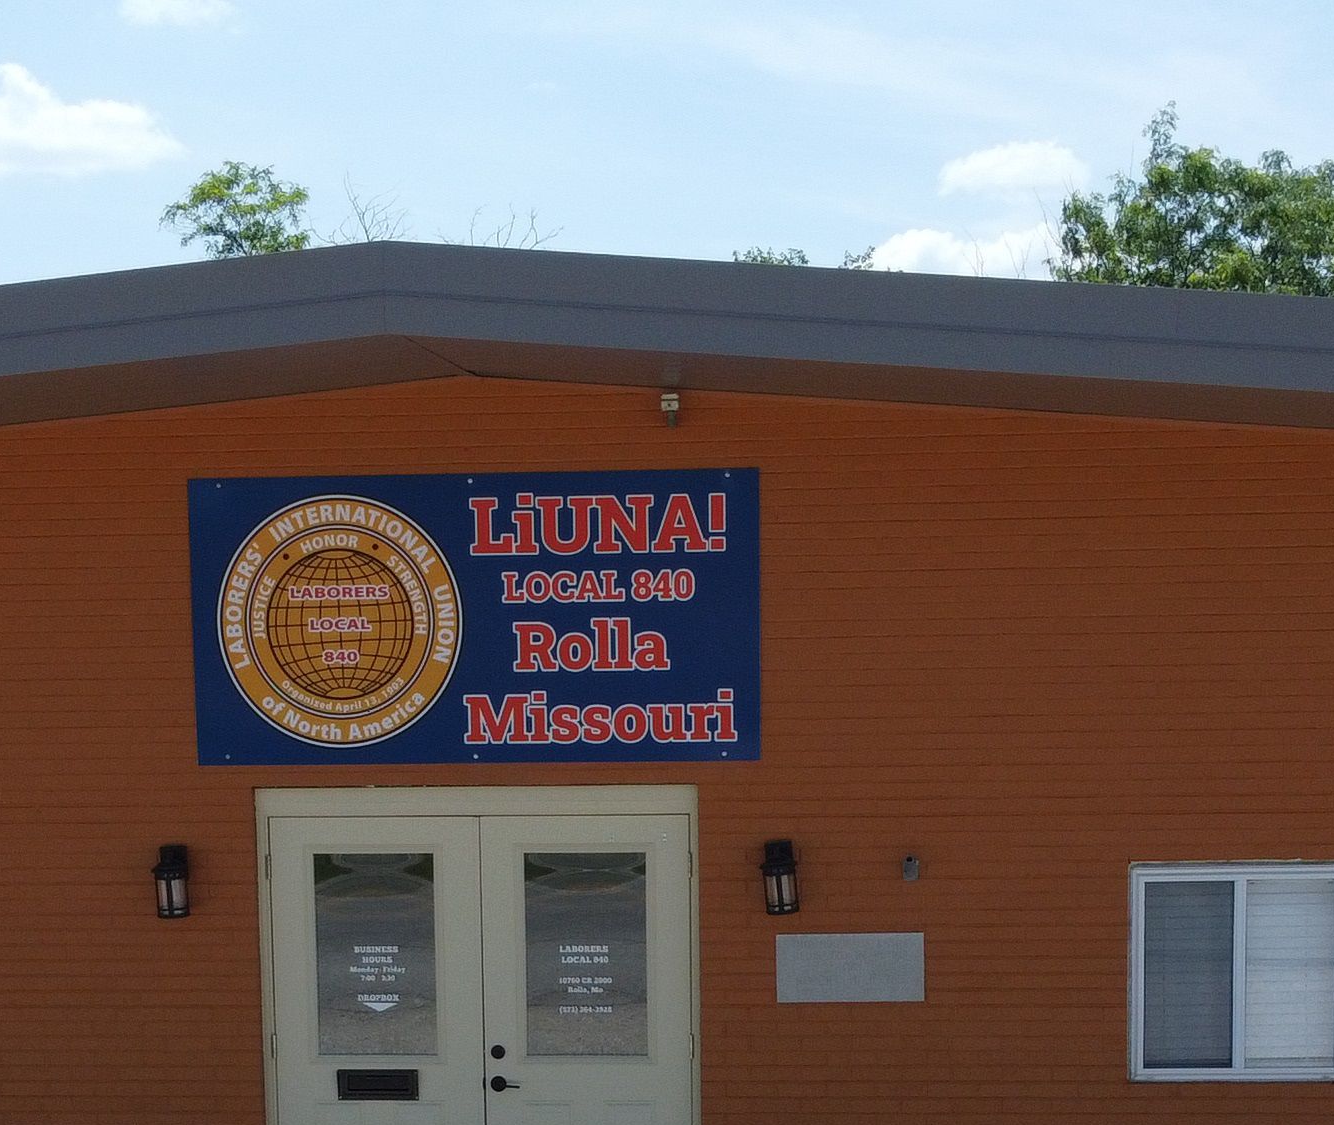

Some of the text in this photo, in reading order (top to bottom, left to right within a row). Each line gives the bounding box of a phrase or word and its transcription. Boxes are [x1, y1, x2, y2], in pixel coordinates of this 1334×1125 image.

[469, 492, 726, 556] LiUNA!
[300, 534, 359, 554] HONOR
[268, 504, 436, 574] INTERNATIONAL
[433, 584, 455, 664] UNION
[288, 584, 390, 601] LABORERS
[386, 555, 428, 635] STRENGTH
[501, 568, 695, 603] LOCAL 840
[253, 575, 278, 640] JUSTICE
[307, 617, 372, 632] LOCAL
[321, 650, 359, 664] 840
[513, 617, 670, 672] Rolla
[281, 680, 332, 711] Organized
[336, 699, 363, 713] April
[381, 677, 405, 700] 1903
[262, 692, 426, 741] of North America
[463, 688, 738, 744] Missouri
[353, 945, 399, 953] BUSINESS
[559, 945, 608, 953] LABORERS
[357, 993, 400, 1001] DROPBOX
